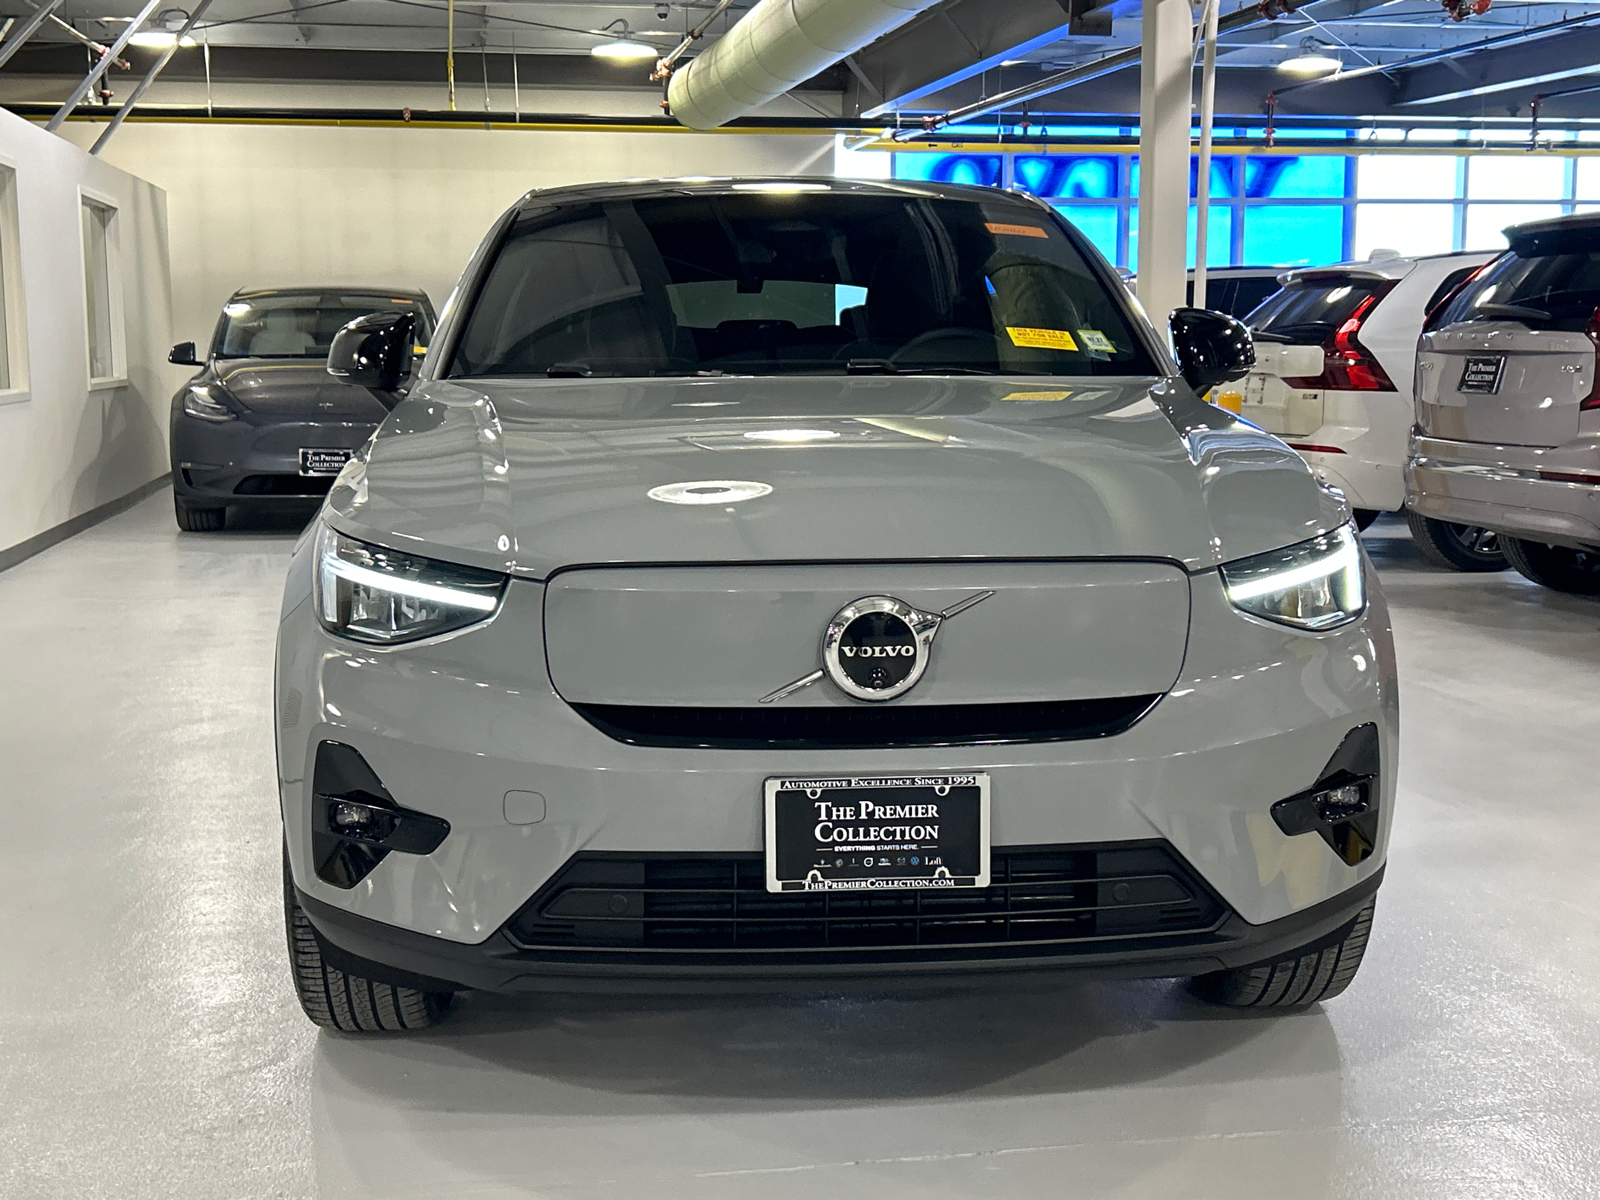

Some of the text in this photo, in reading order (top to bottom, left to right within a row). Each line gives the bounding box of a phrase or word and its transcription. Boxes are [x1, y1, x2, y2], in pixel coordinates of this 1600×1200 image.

[841, 645, 915, 657] VOLVO
[782, 776, 975, 789] AUTOMOTIVE EXCELLENCE SINCE 1995
[814, 800, 939, 820] THE PREMIER
[814, 821, 939, 842] COLLECTION
